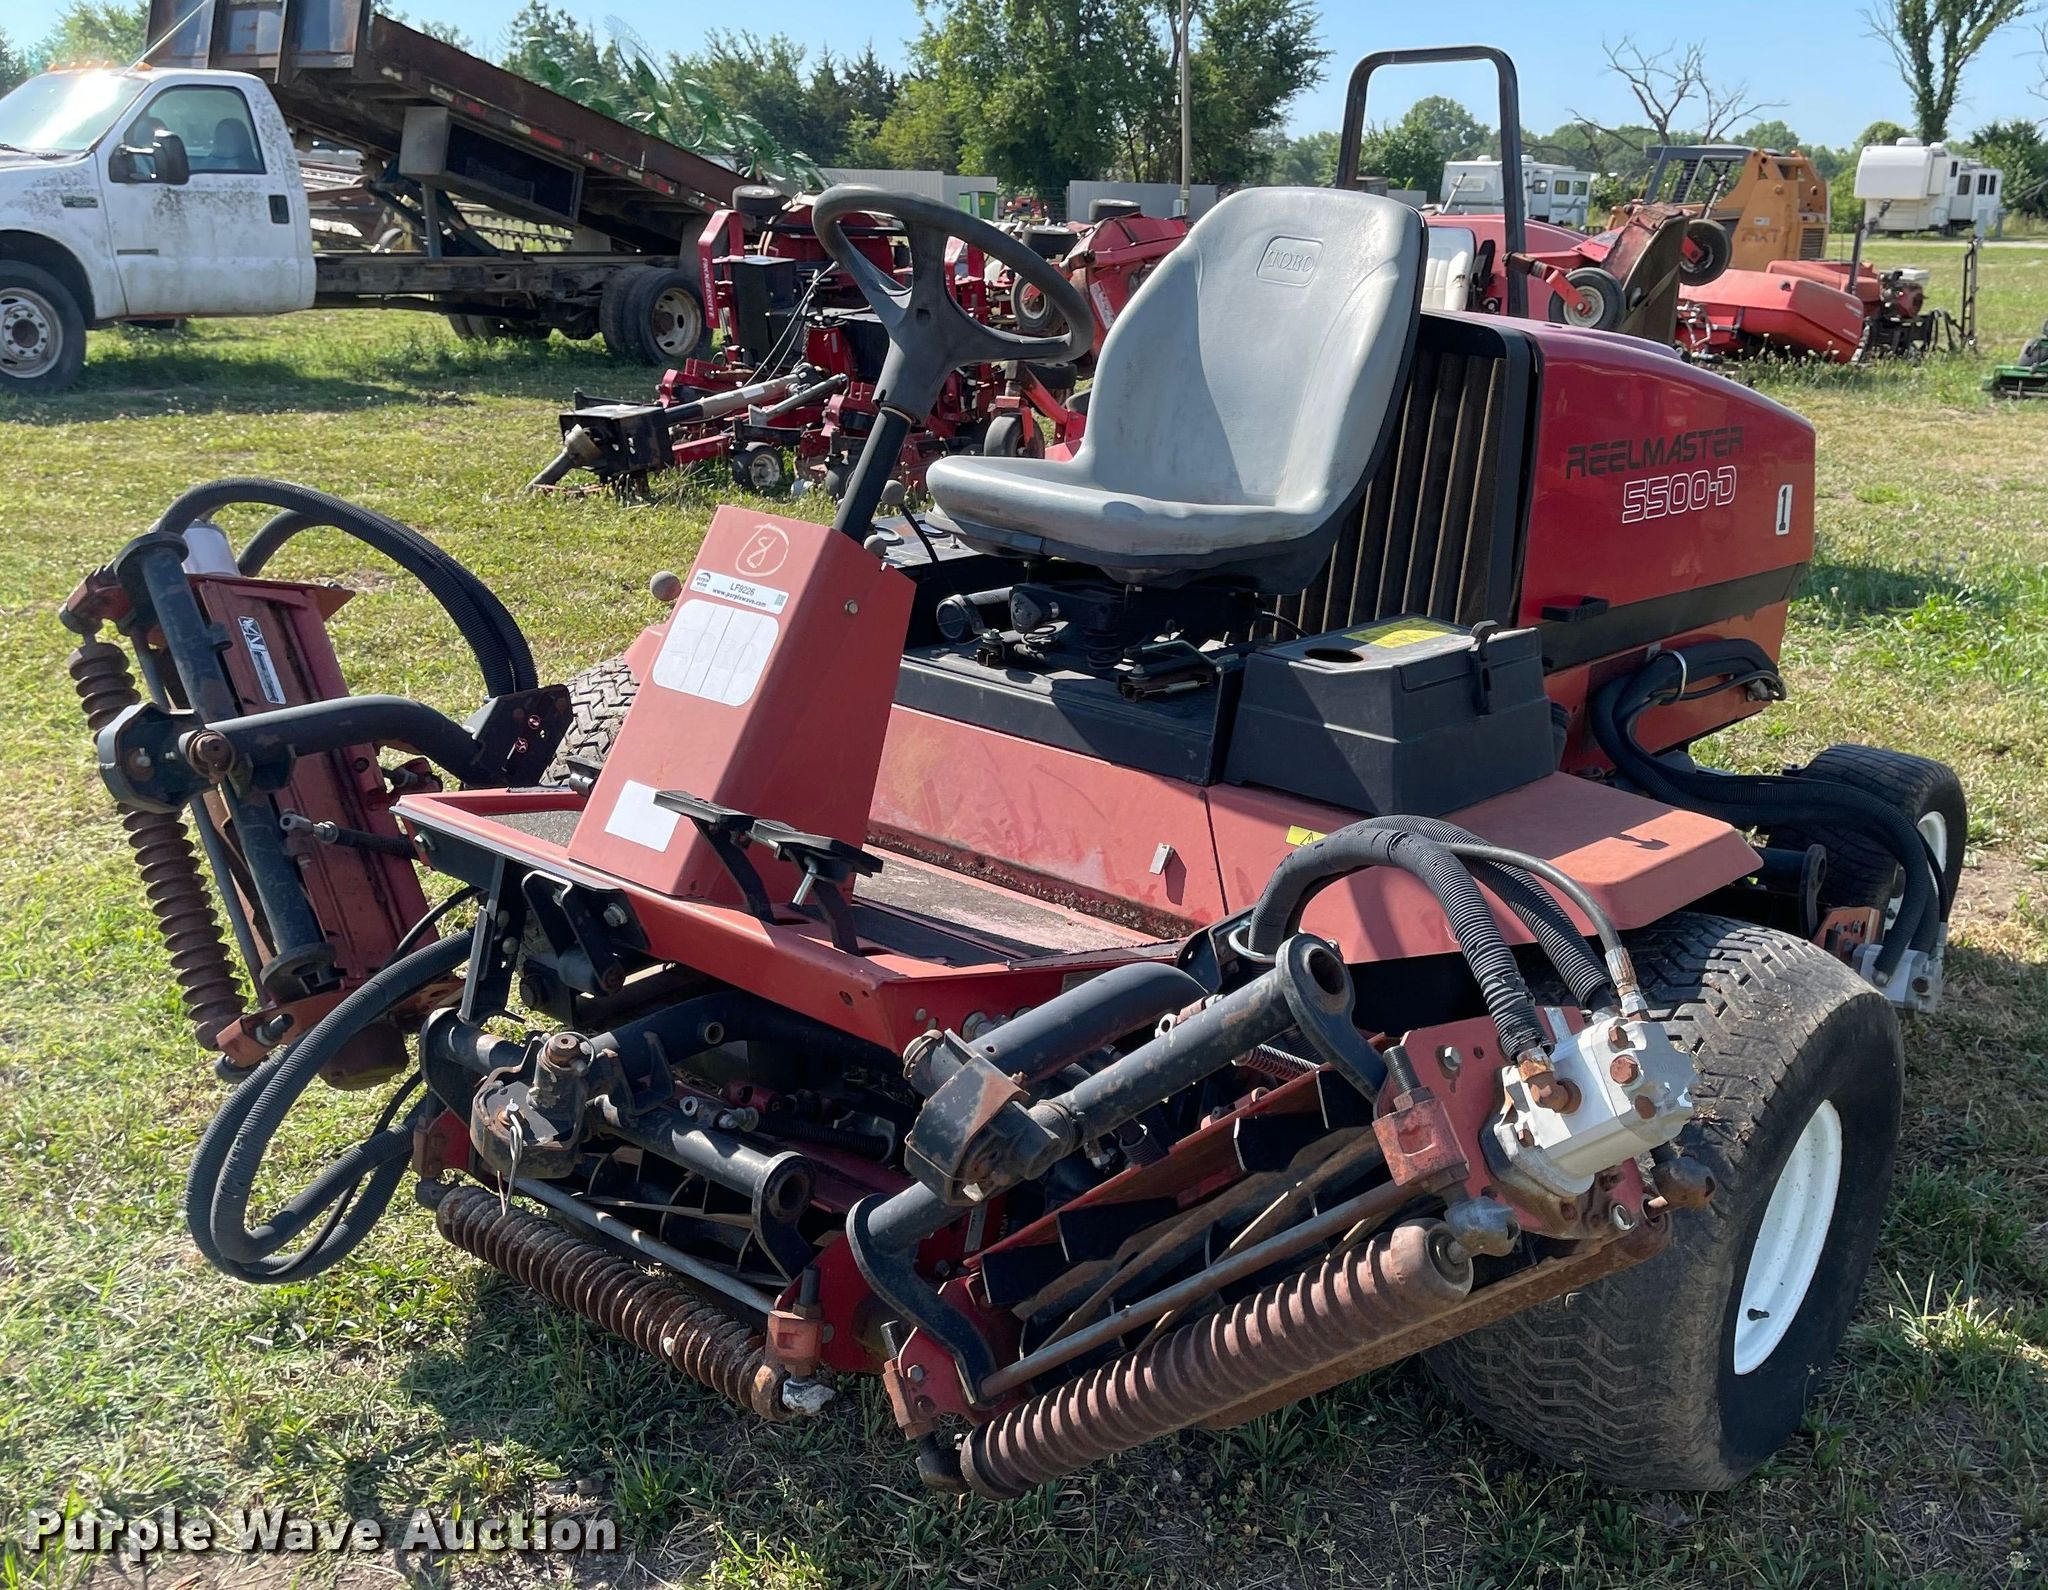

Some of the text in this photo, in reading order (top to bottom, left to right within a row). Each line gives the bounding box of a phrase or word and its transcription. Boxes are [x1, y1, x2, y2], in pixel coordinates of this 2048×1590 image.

[1565, 425, 1745, 480] REELMASTER
[1621, 465, 1737, 524] 5500-D
[746, 536, 778, 569] 8
[712, 588, 767, 608] www.purplewave.com
[730, 582, 756, 597] LF9226
